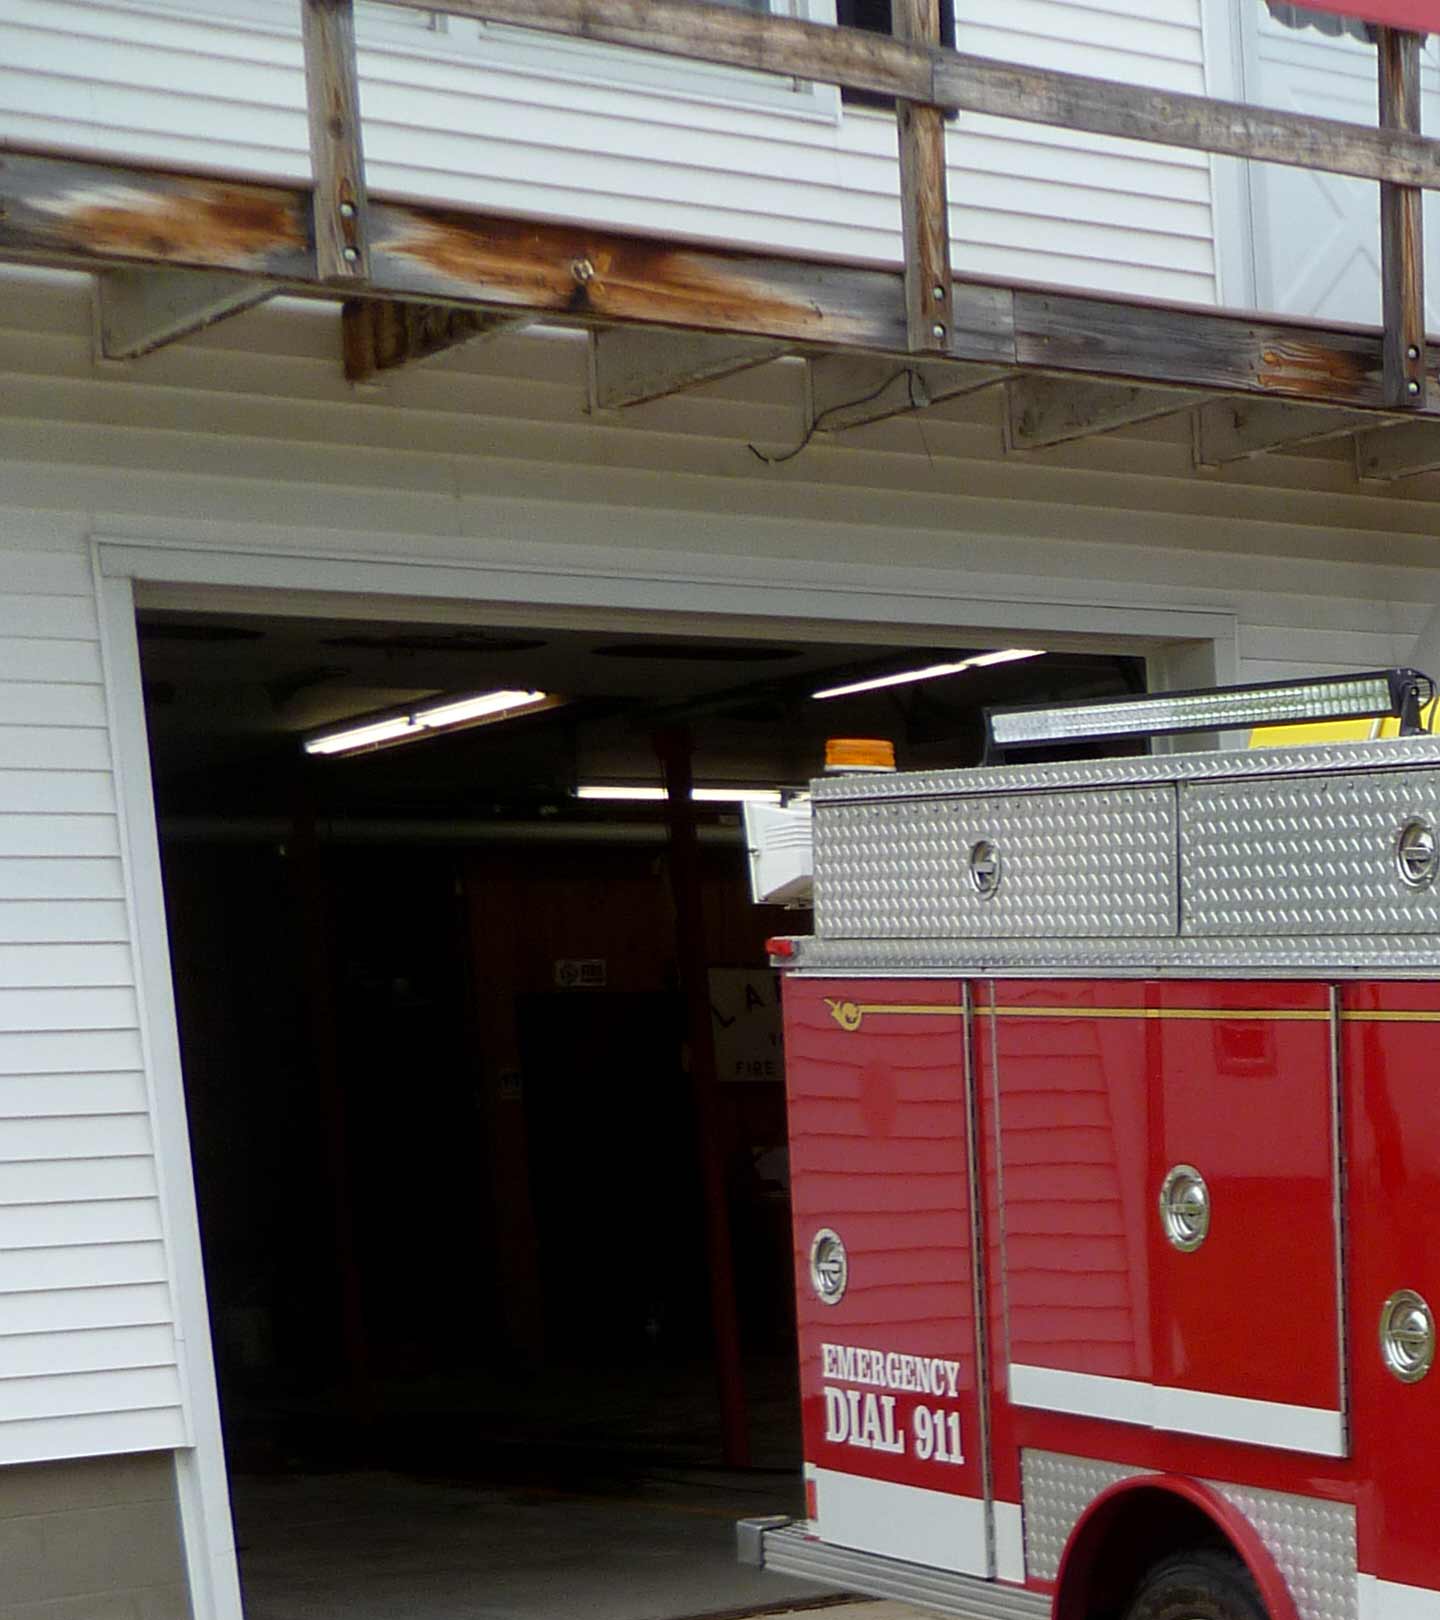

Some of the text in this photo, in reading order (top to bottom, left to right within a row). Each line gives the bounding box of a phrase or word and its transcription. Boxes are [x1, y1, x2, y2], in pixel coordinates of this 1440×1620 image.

[821, 1343, 960, 1397] EMERGENCY
[824, 1386, 965, 1464] DIAL 911
